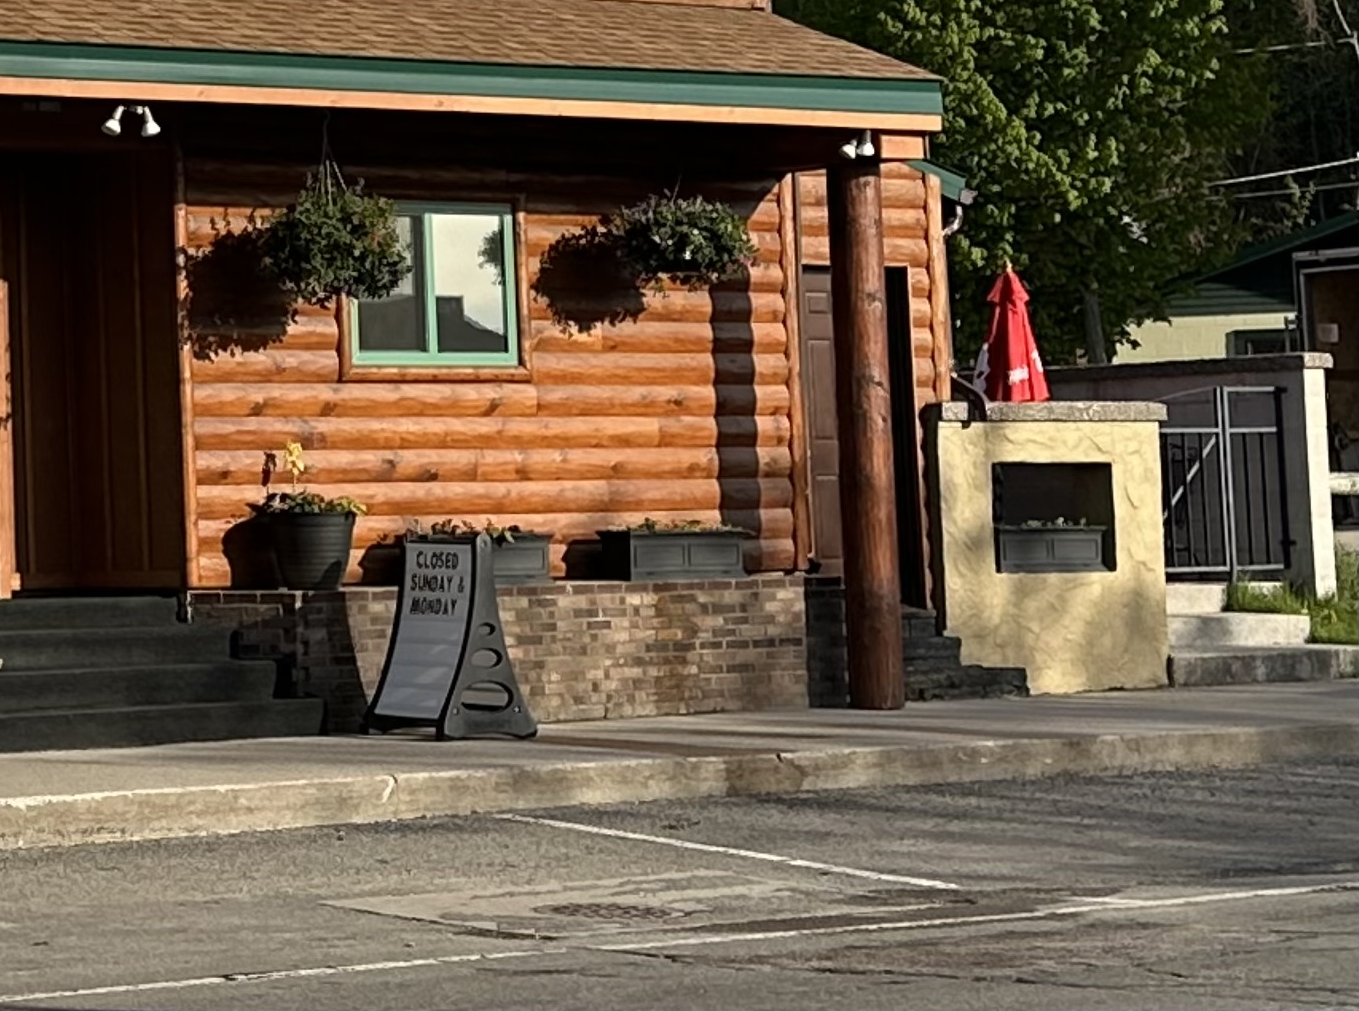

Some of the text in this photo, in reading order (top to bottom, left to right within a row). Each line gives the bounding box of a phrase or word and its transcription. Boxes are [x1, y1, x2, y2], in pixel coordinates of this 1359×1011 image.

[415, 550, 459, 570] CLOSED
[410, 574, 454, 593] SUNDAY
[409, 596, 458, 616] MONDAY
